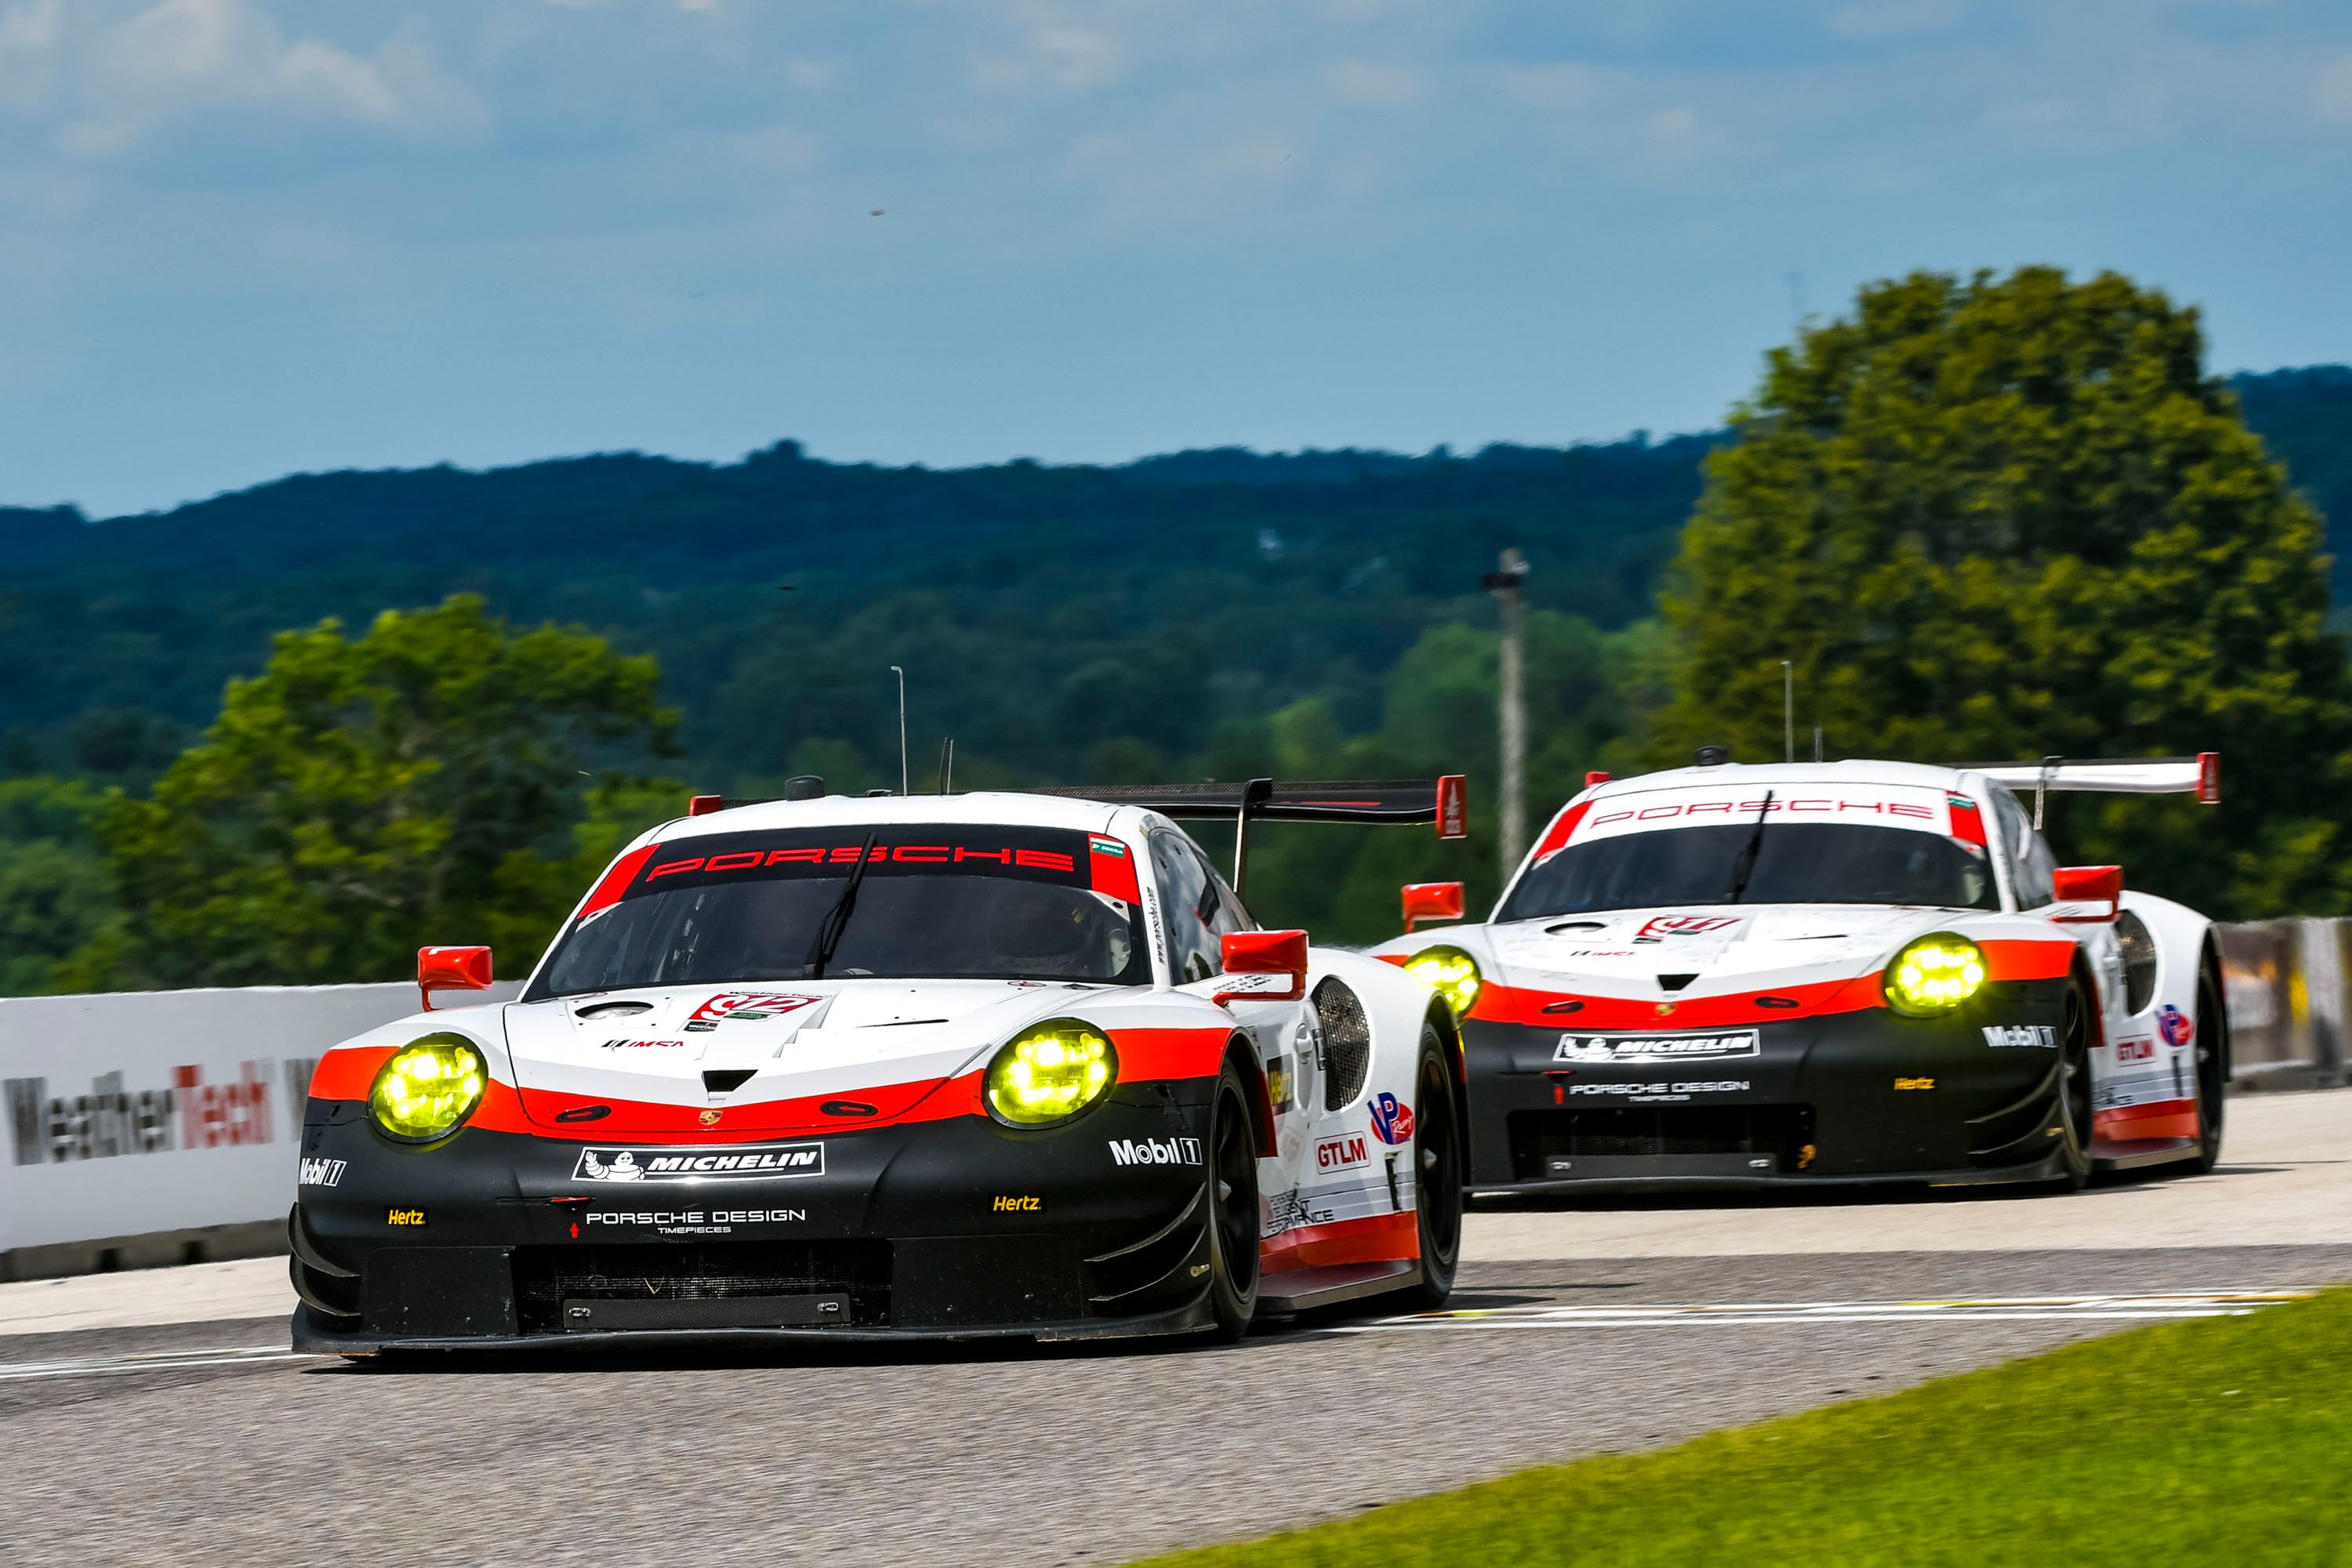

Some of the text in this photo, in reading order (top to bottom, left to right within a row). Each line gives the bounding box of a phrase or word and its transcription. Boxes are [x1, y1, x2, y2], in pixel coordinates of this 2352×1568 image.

[1590, 800, 1934, 829] PORSCHE
[646, 846, 1074, 882] PORSCHE
[701, 993, 808, 1021] 912
[1615, 1036, 1752, 1053] MICHELIN
[1569, 1080, 1750, 1094] PORSCHE DESIGN
[1894, 1076, 1935, 1091] Hertz
[648, 1151, 818, 1171] MICHELIN
[1108, 1138, 1182, 1166] Mobil
[1318, 1138, 1367, 1167] GTLM
[299, 1157, 331, 1185] Mobil
[586, 1209, 806, 1225] PORSCHE DESIGN
[657, 1226, 731, 1235] TIMEPIECES
